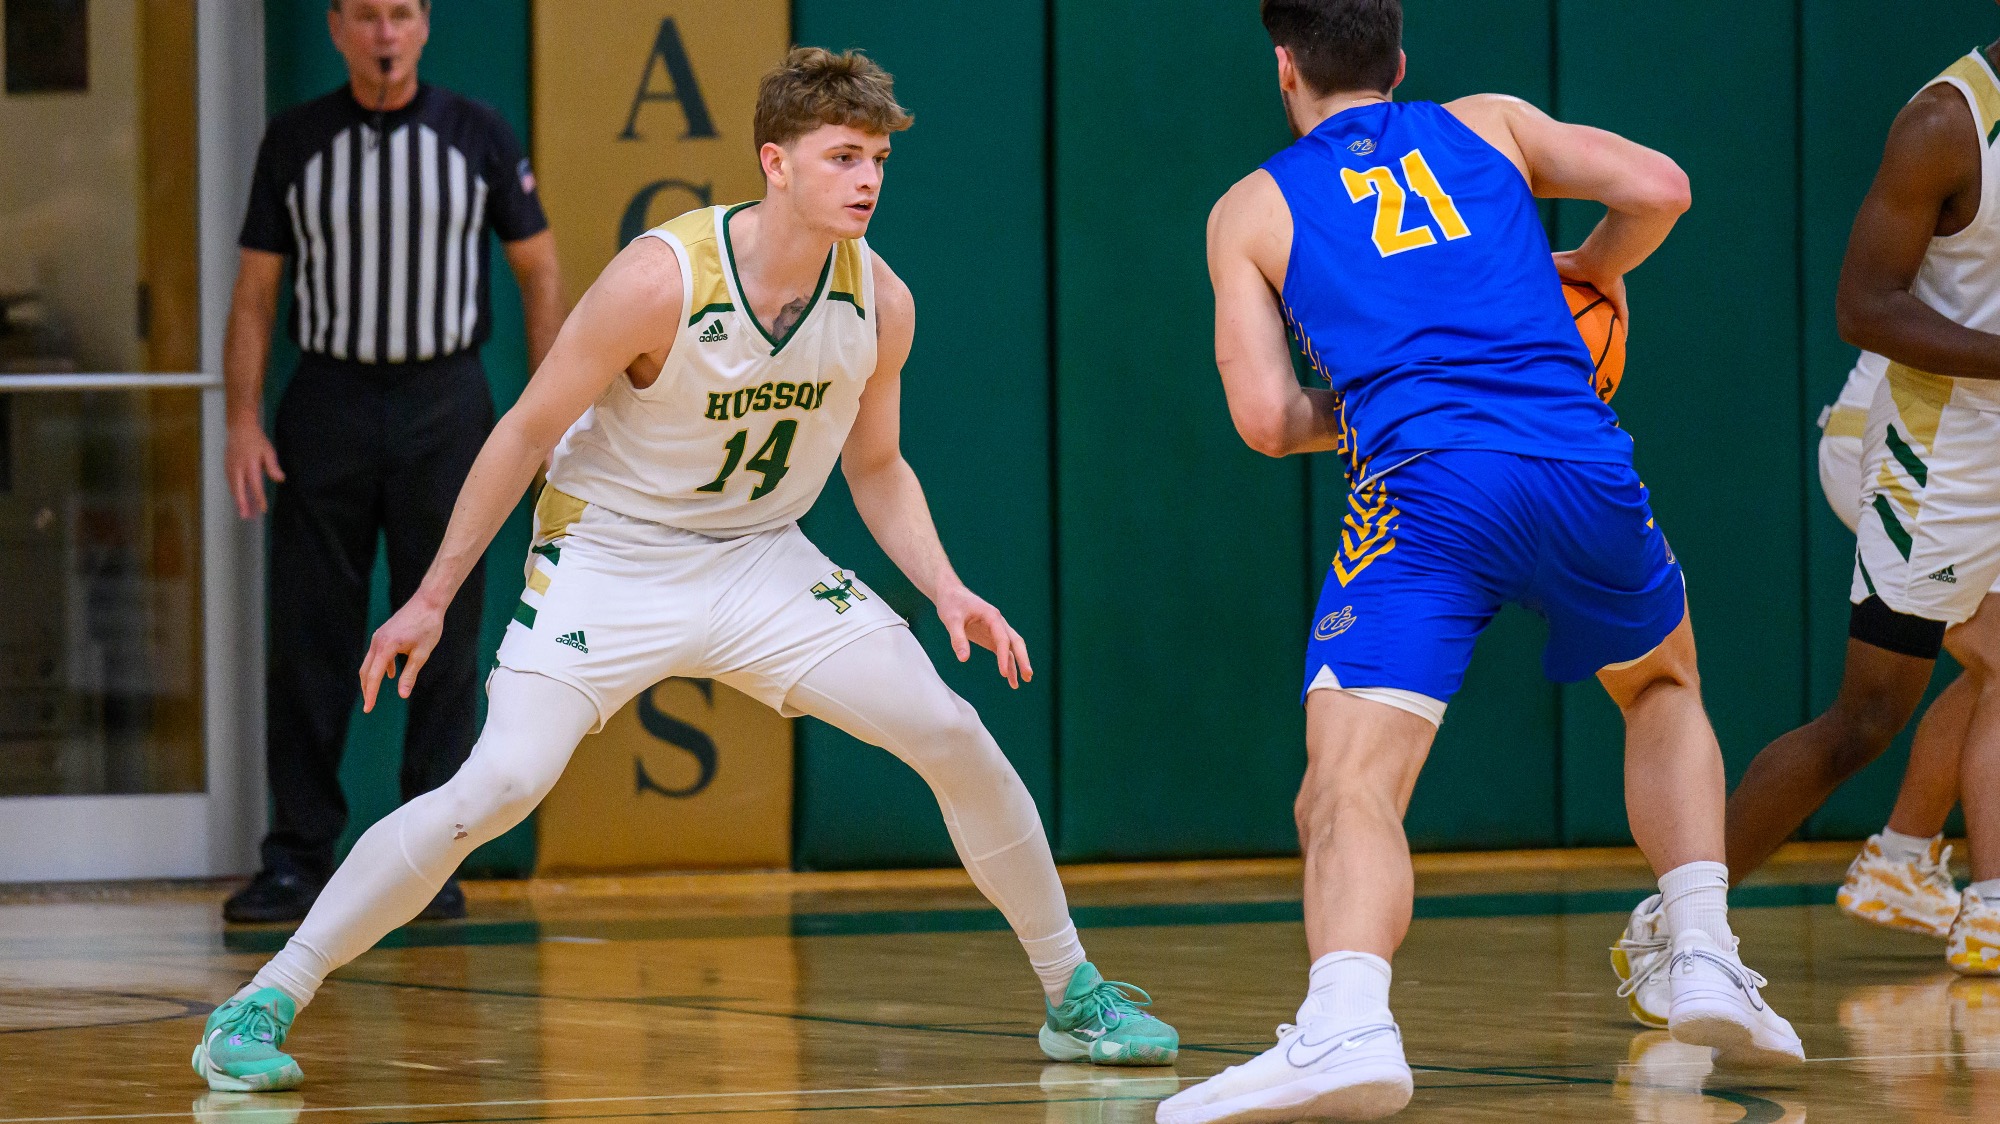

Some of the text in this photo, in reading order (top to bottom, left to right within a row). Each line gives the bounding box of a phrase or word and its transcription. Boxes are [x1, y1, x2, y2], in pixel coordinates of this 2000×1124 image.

[1341, 148, 1472, 258] 21
[699, 332, 728, 343] adidas
[694, 418, 799, 502] 14
[555, 637, 589, 654] adidas
